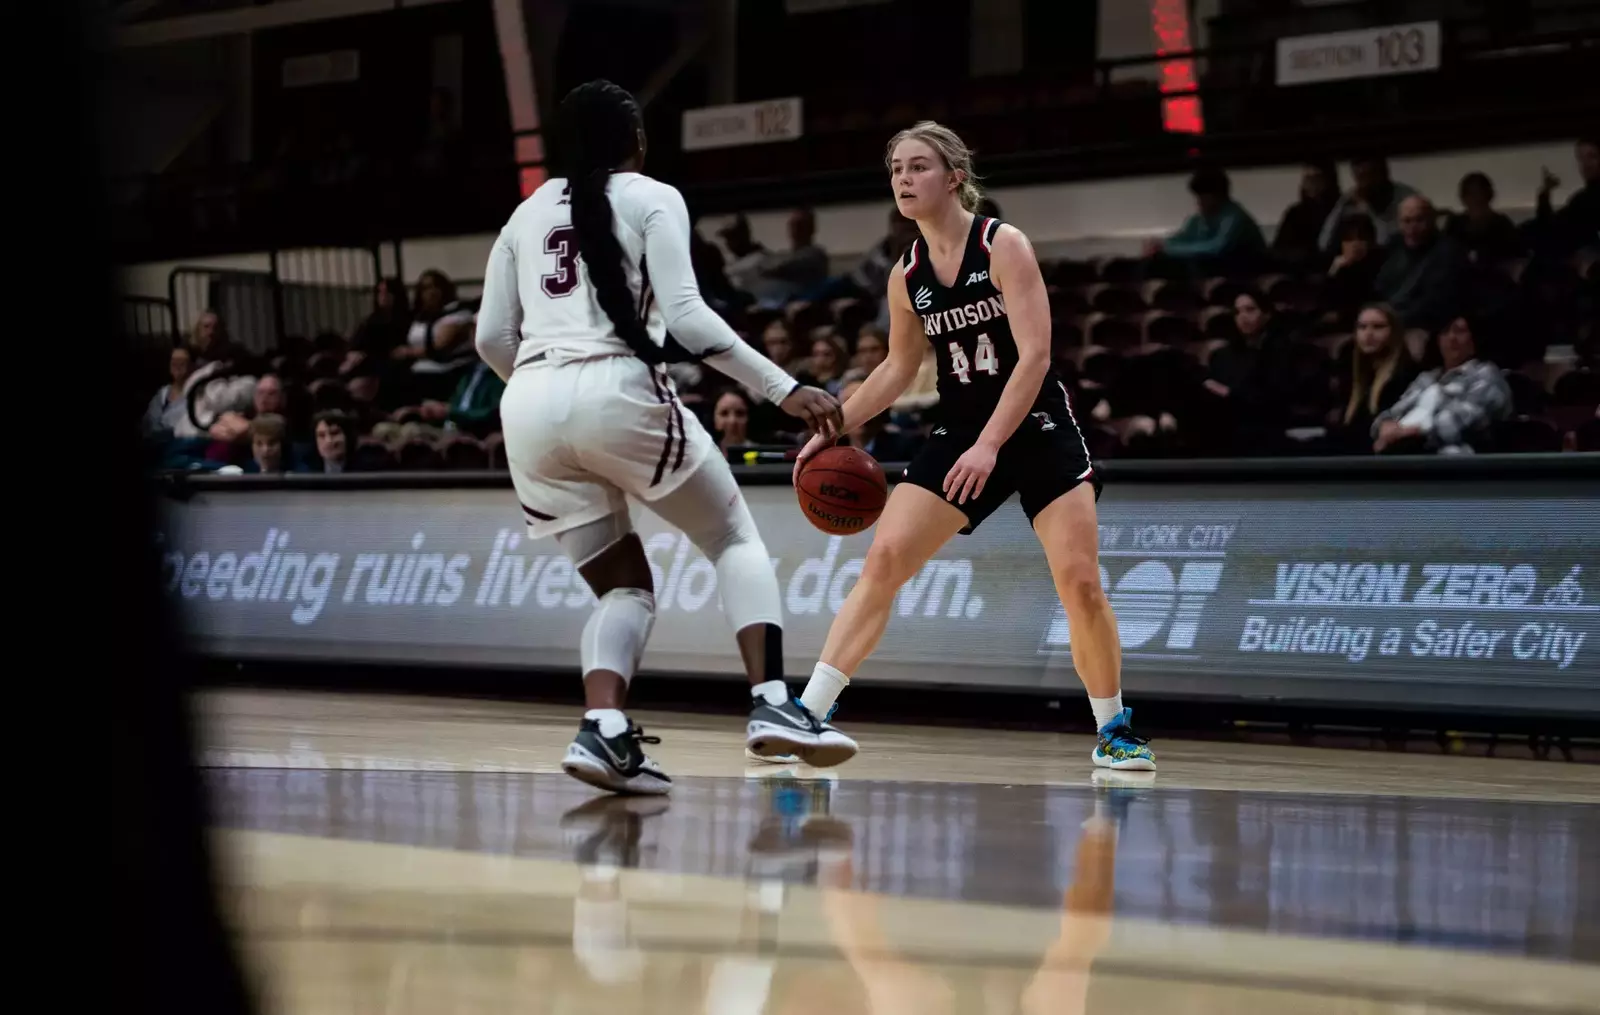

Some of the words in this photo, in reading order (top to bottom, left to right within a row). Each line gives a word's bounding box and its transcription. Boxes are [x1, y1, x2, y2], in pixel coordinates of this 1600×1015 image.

[1375, 27, 1426, 68] 103
[947, 332, 1000, 385] 44
[807, 502, 864, 529] Wilson
[1132, 523, 1184, 549] YORK
[1187, 523, 1236, 551] CITY
[343, 532, 472, 606] ruins
[1273, 562, 1411, 604] VISION
[1413, 563, 1538, 606] ZERO
[1237, 615, 1376, 664] Building
[1379, 627, 1403, 656] a
[1410, 619, 1507, 660] Safer
[1512, 622, 1588, 671] City
